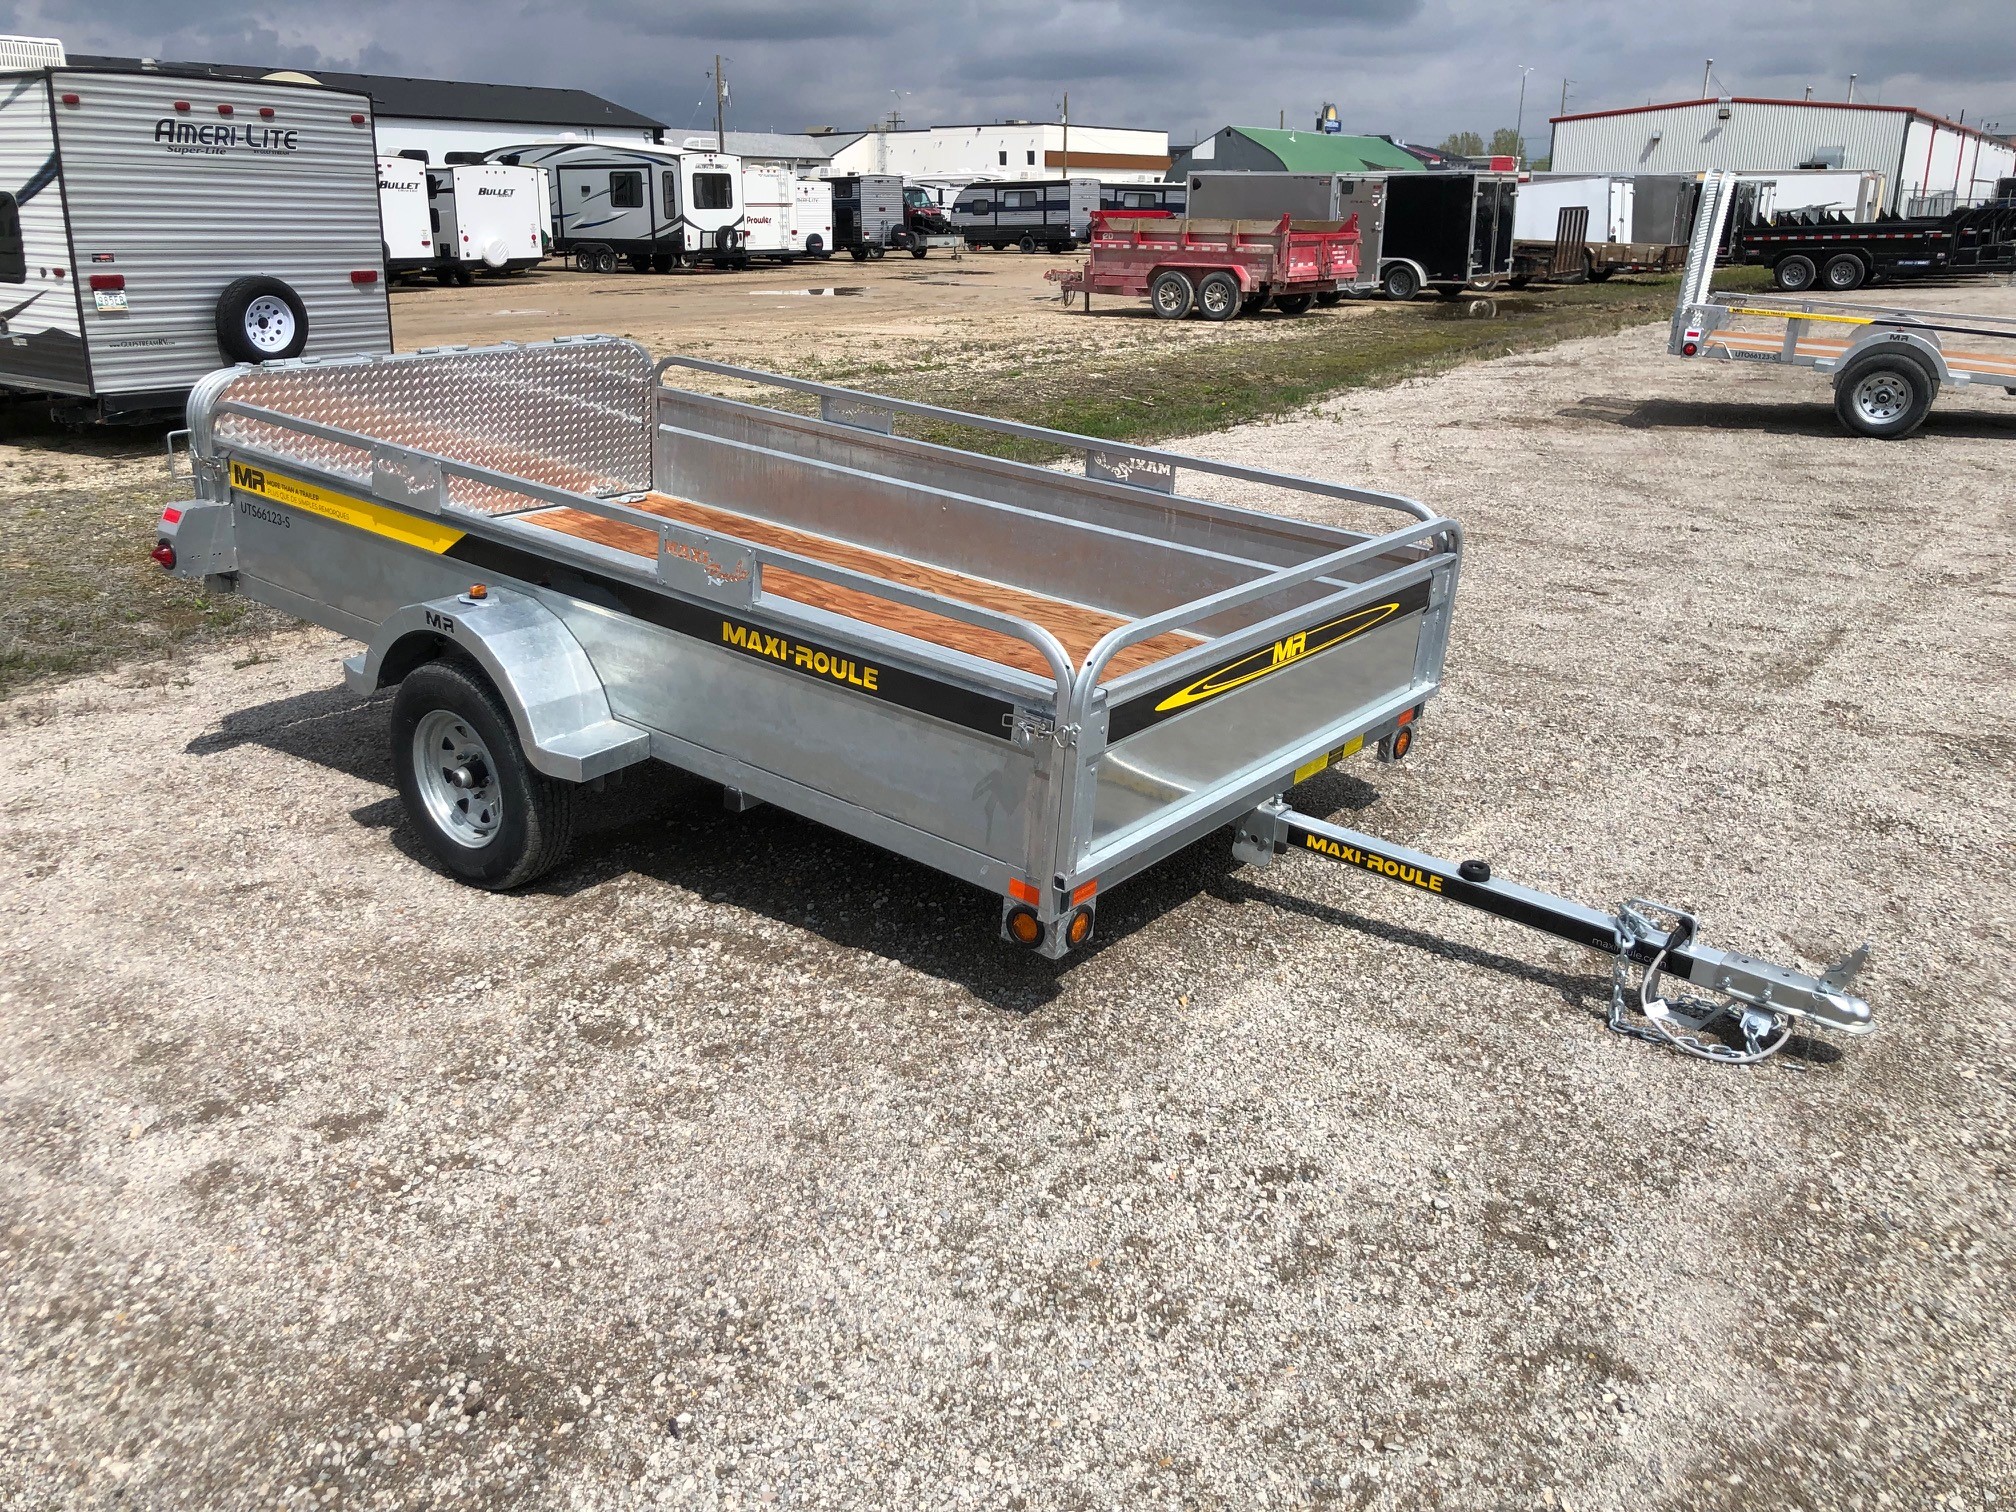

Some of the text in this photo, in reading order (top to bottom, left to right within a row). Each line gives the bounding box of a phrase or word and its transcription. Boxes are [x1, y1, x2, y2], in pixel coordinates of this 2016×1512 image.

[167, 145, 226, 155] Super-Lite
[746, 216, 772, 224] Prowler
[1889, 333, 1909, 342] MR
[234, 464, 266, 493] MR
[266, 480, 281, 489] MORE
[281, 483, 294, 493] THAN
[299, 490, 320, 501] TRAILER
[240, 501, 291, 528] UTS66123-S
[267, 488, 350, 520] PLUS QUE DE SIMPLES REMORQUES
[425, 610, 455, 634] MR
[722, 621, 879, 691] MAXI-ROULE
[1272, 631, 1307, 665] MR
[1306, 834, 1444, 892] MAXI-ROULE
